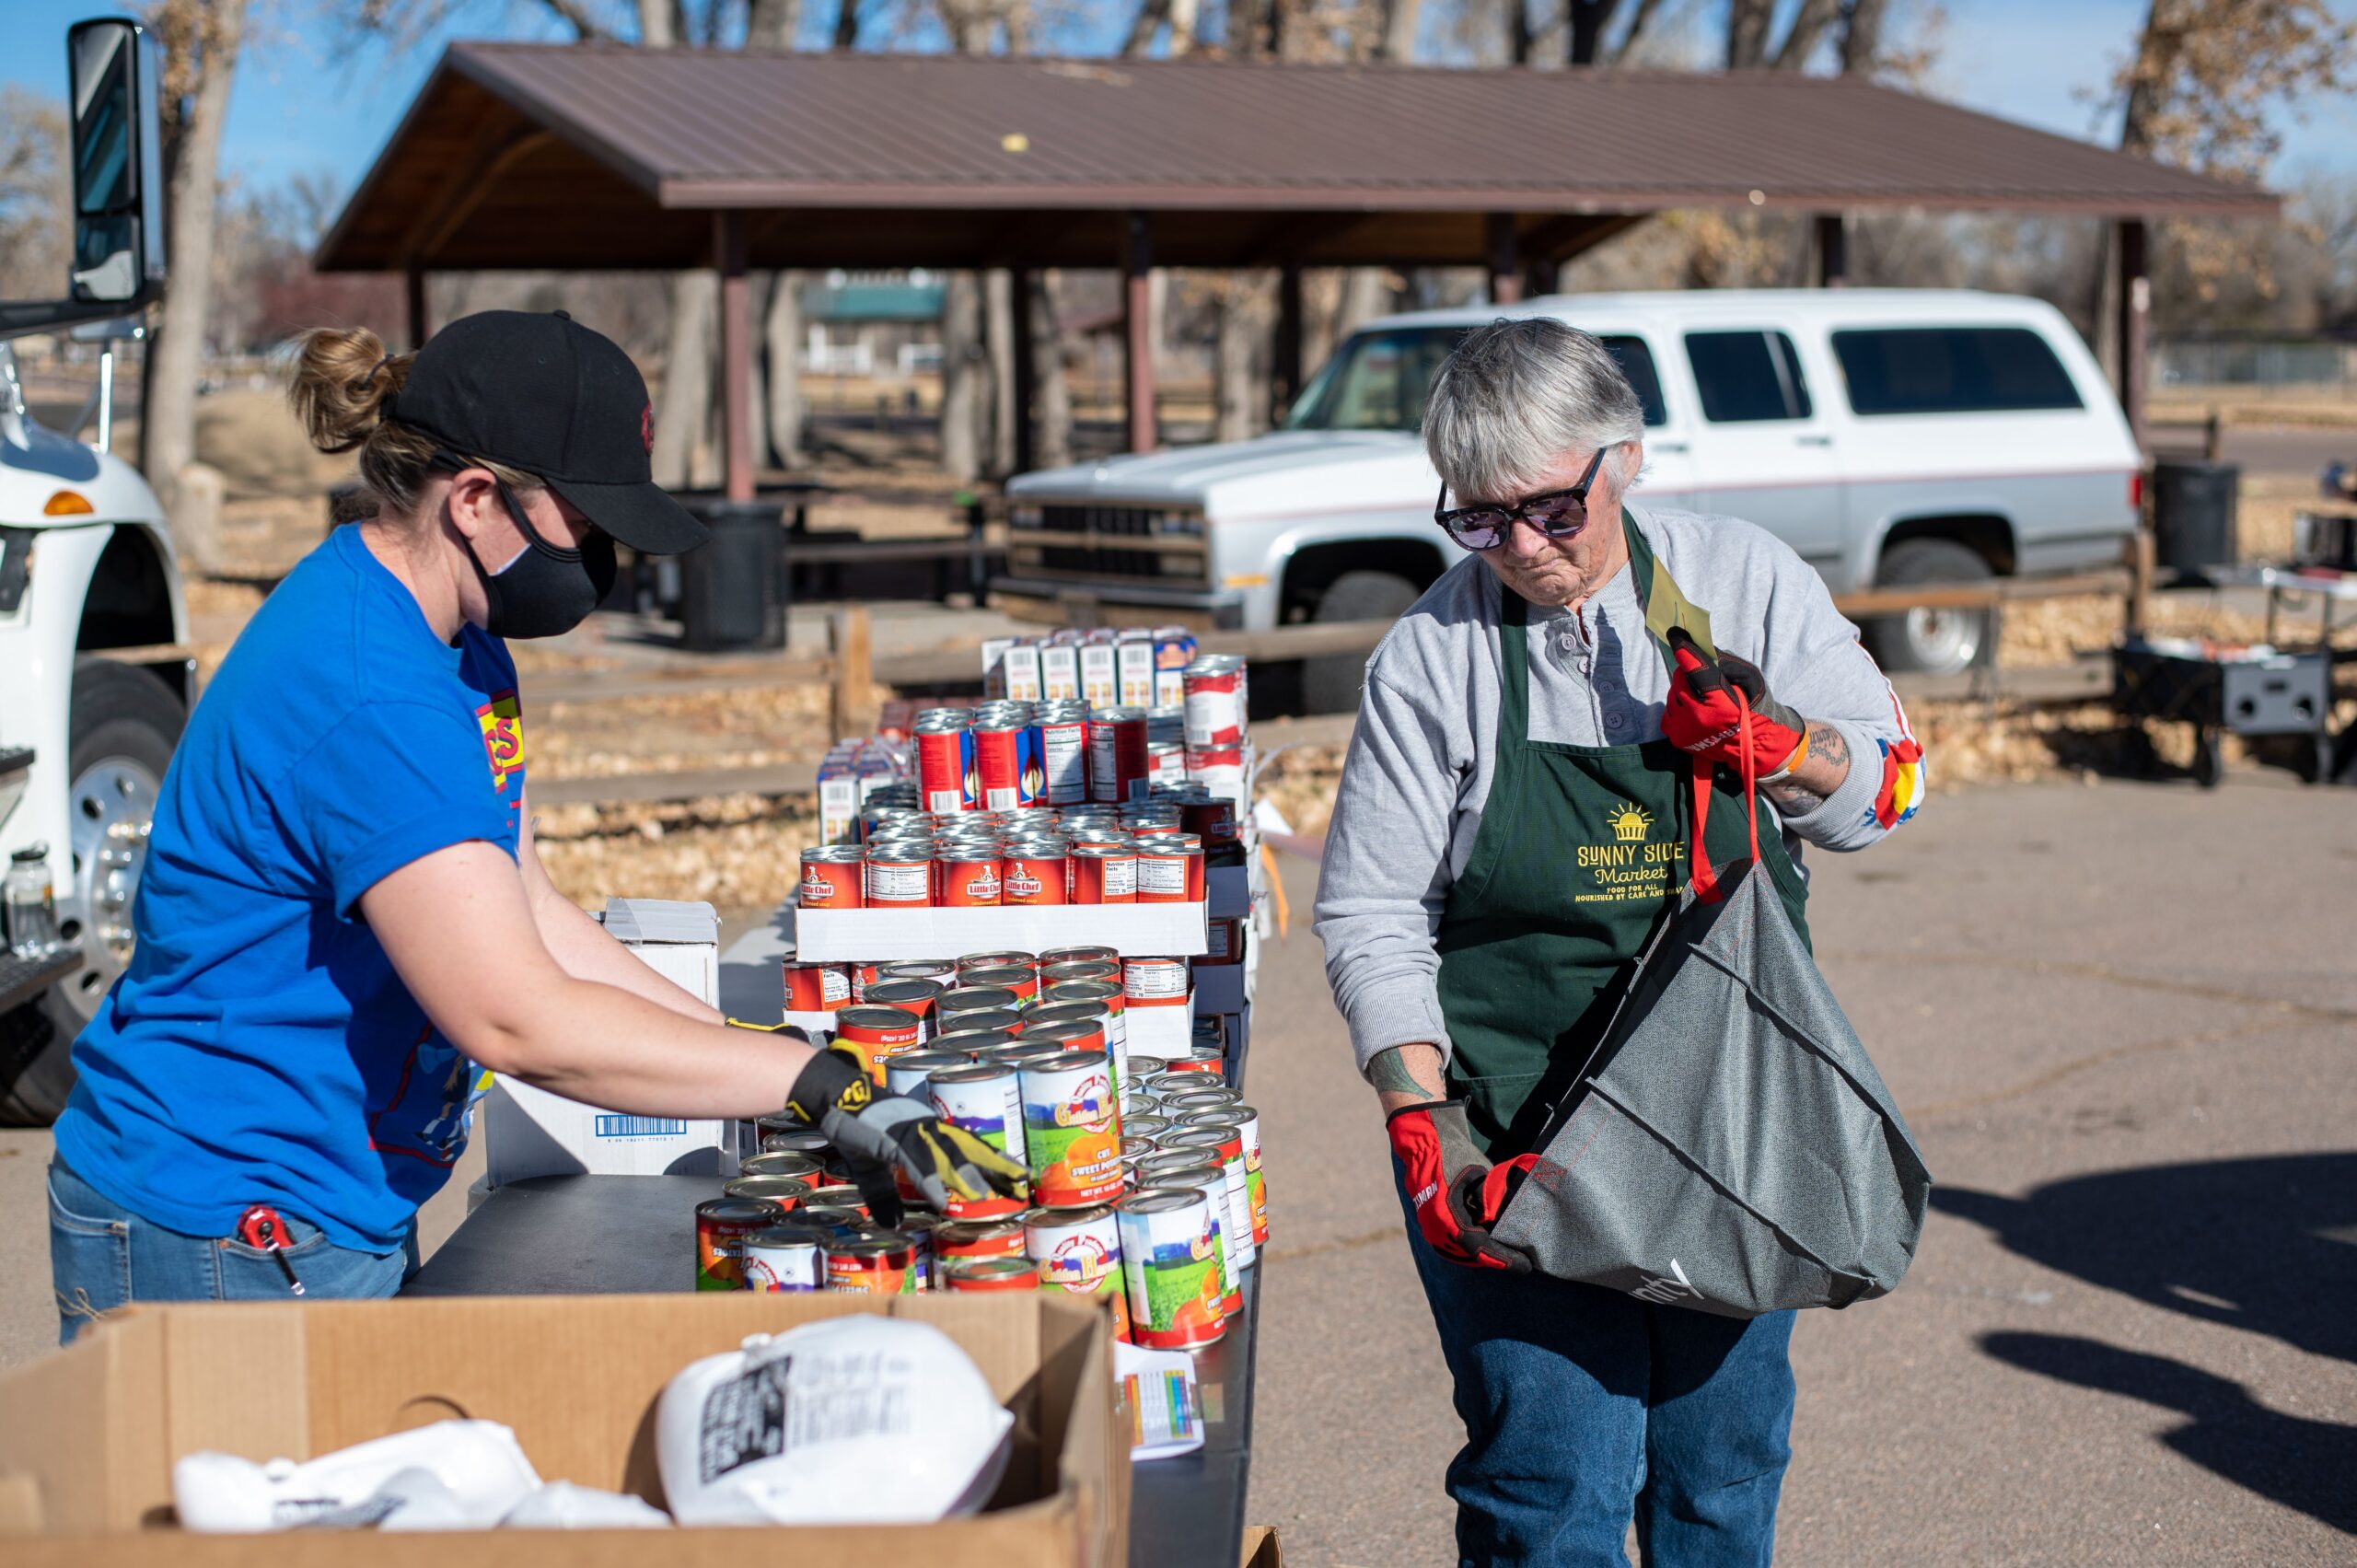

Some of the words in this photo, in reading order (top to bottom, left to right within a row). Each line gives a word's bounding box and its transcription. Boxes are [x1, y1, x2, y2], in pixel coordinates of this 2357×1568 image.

[1577, 844, 1637, 866] SUNNY
[1644, 842, 1686, 863] SIDE
[1594, 865, 1668, 884] Market
[815, 885, 831, 894] Chef
[970, 882, 990, 893] Little
[1005, 880, 1020, 890] Little
[1021, 881, 1039, 890] Chef
[1575, 893, 1614, 902] NOURISHED
[1628, 890, 1646, 900] CARE
[1649, 889, 1665, 897] AND
[1097, 1147, 1110, 1159] CUT
[1072, 1162, 1099, 1177] SWEET
[1080, 1189, 1092, 1198] NET
[1412, 1179, 1438, 1213] TSMAN
